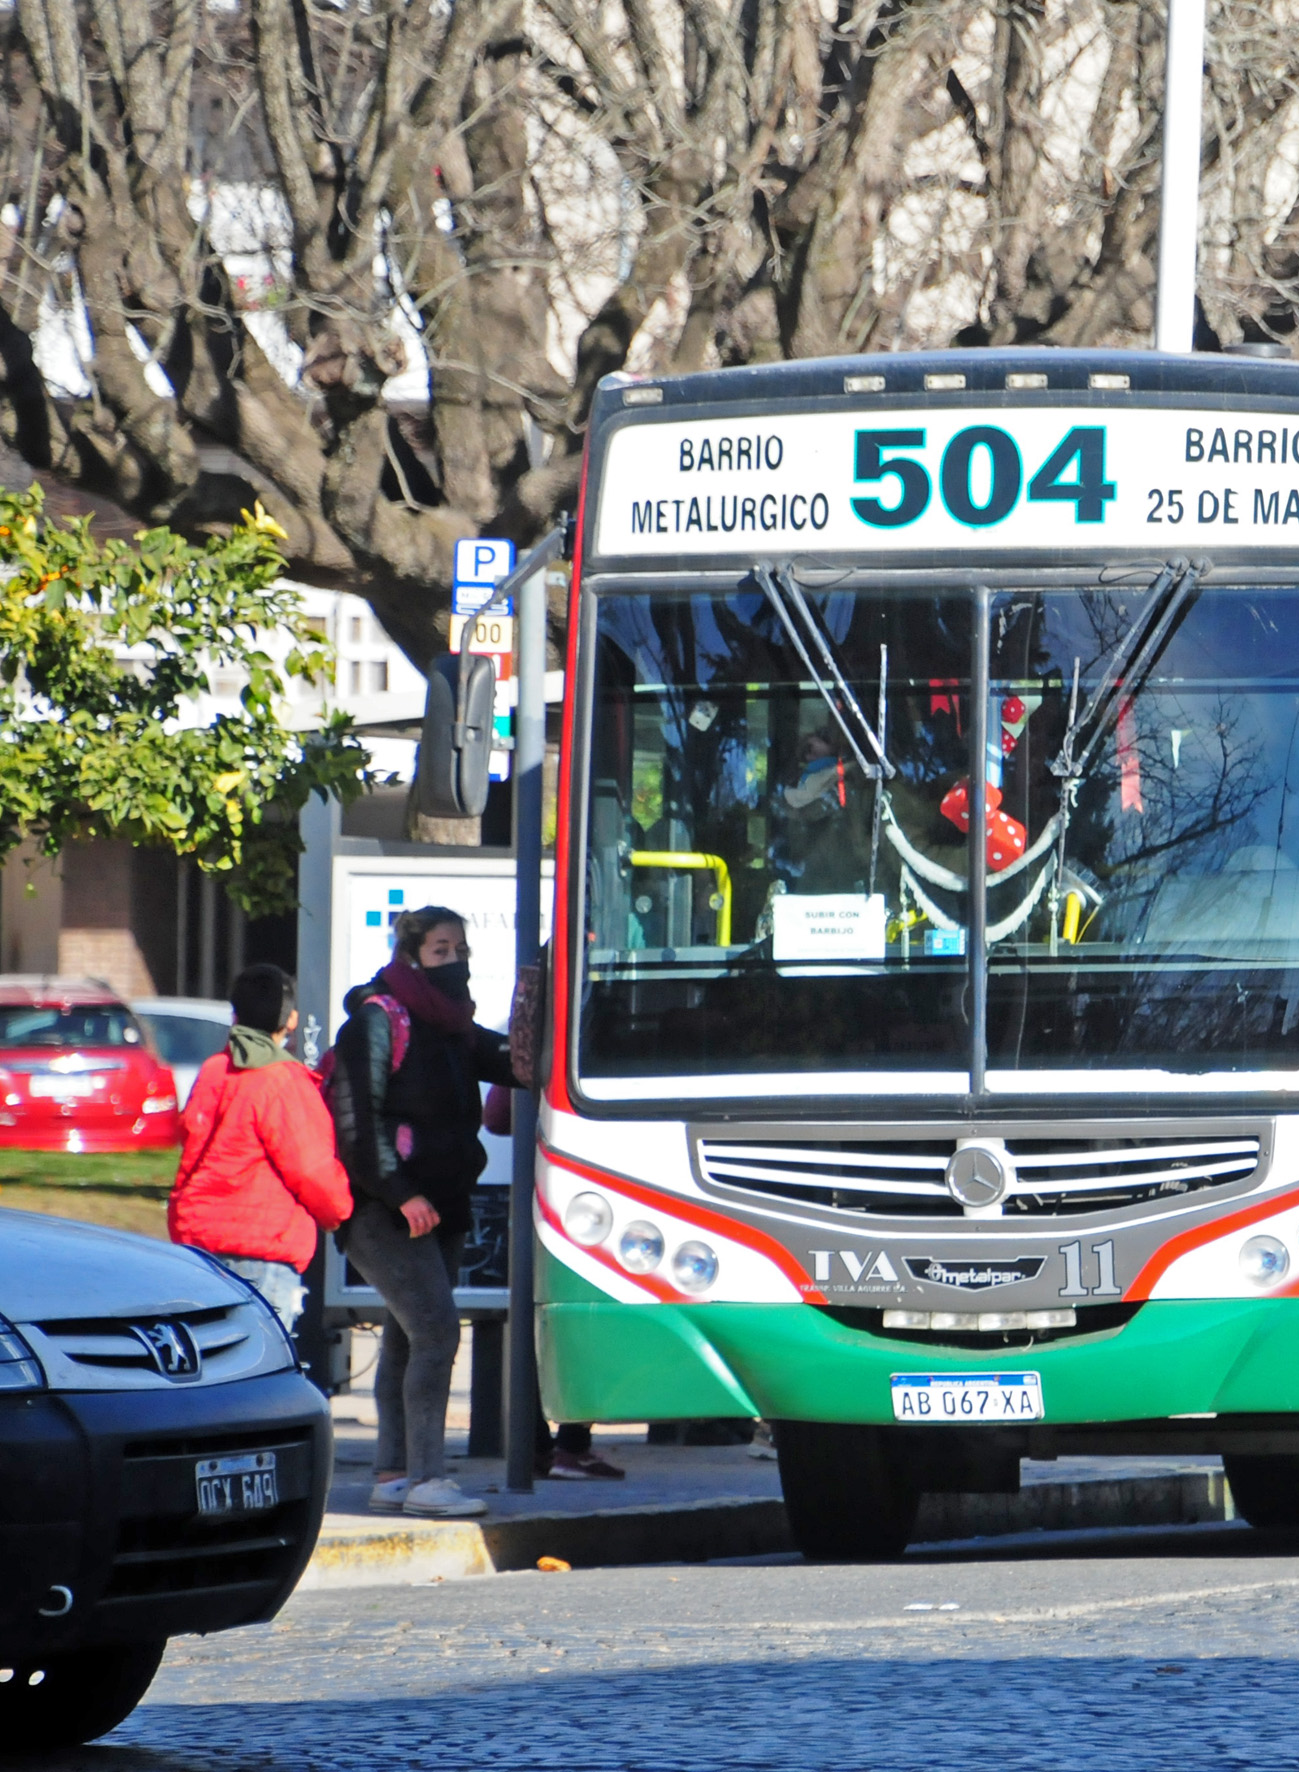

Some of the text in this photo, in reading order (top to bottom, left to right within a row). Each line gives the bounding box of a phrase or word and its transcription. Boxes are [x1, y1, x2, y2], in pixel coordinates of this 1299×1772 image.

[678, 434, 785, 473] BARRIO
[850, 424, 1117, 530] 504
[631, 491, 830, 534] METALURGICO
[1145, 487, 1185, 525] 25
[1197, 487, 1240, 525] DE
[474, 546, 497, 576] P
[466, 622, 502, 644] 00
[804, 911, 860, 919] SUBIR CON
[809, 927, 855, 935] BARBIJO
[808, 1250, 899, 1283] TVA
[1058, 1239, 1122, 1297] 11
[833, 1284, 856, 1293] VILLA
[902, 1389, 1034, 1416] AB 067 XA
